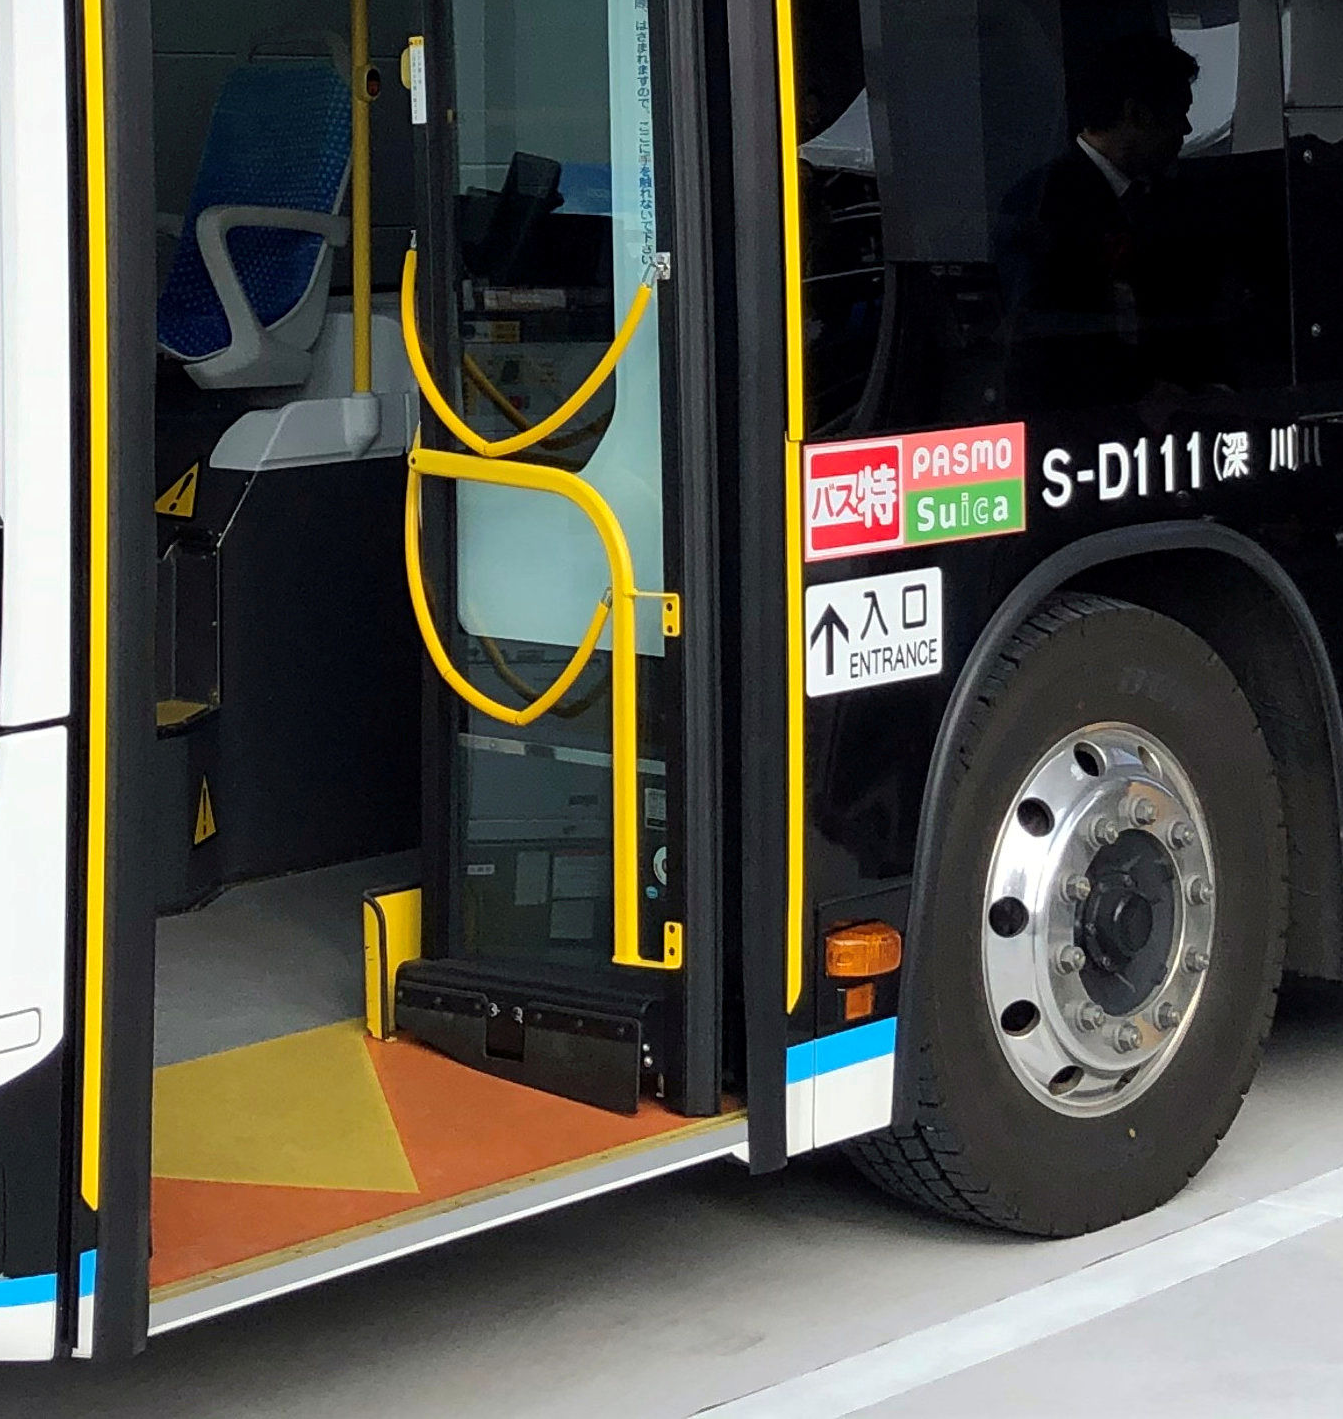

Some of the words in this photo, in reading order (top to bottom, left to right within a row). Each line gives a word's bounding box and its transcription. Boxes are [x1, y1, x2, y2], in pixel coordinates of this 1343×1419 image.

[911, 437, 1013, 481] PASMO
[1041, 430, 1202, 509] S-D111
[916, 492, 1009, 533] Suica
[860, 583, 928, 641] 入口
[849, 637, 939, 679] ENTRANCE
